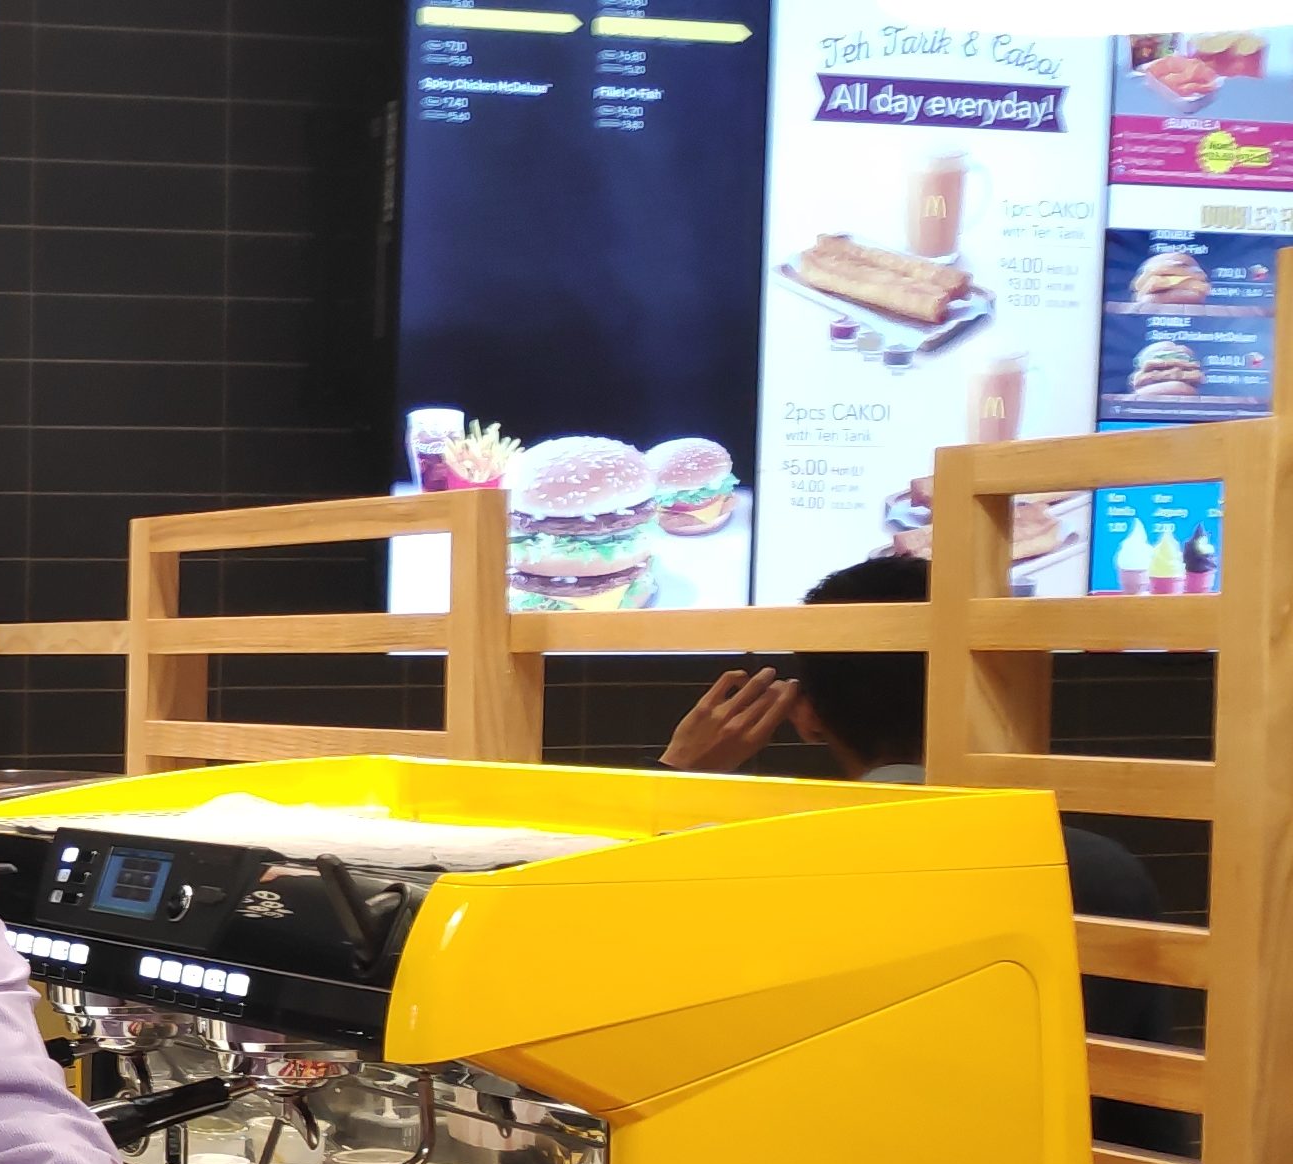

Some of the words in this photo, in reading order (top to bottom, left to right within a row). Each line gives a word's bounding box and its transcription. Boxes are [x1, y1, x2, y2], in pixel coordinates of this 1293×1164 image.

[821, 31, 870, 68] Teh
[882, 25, 950, 57] Tarik
[827, 82, 869, 112] All
[870, 84, 924, 123] day
[924, 90, 1056, 130] everyday!
[784, 402, 826, 424] 2pcs
[832, 403, 891, 421] CAKOI
